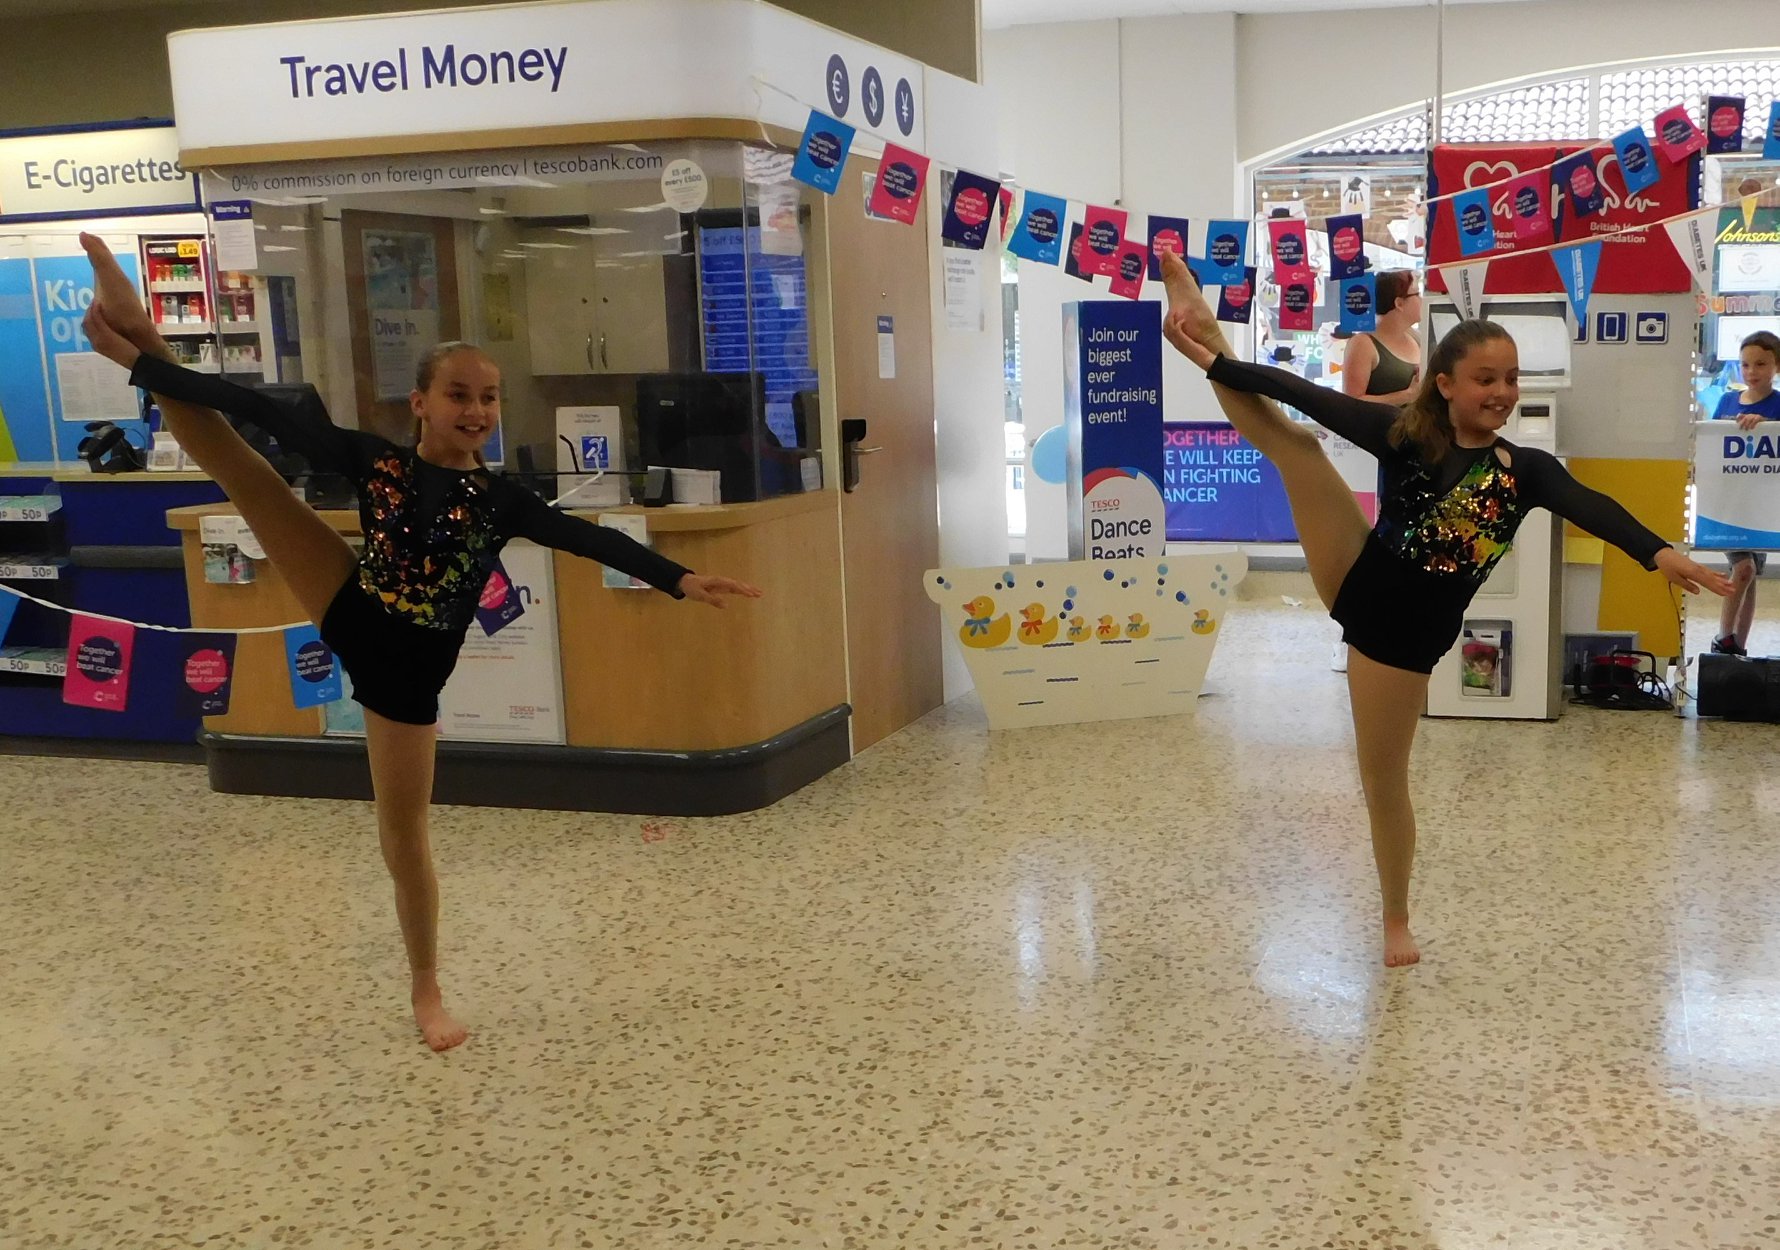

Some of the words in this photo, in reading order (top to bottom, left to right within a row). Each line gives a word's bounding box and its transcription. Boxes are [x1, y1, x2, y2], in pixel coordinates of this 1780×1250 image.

[280, 48, 409, 98] Travel
[421, 44, 568, 92] Money
[24, 158, 187, 193] E-Cigarettes
[232, 175, 258, 192] 0%
[263, 173, 356, 190] commission
[362, 171, 381, 184] on
[387, 166, 443, 184] foreign
[449, 162, 518, 180] currency
[533, 153, 663, 174] tescobank.com
[1590, 222, 1620, 232] British
[44, 280, 95, 312] Kio
[375, 318, 400, 335] Dive
[1088, 327, 1114, 342] Join
[1118, 330, 1139, 341] our
[1088, 348, 1132, 366] biggest
[1088, 371, 1115, 383] ever
[1088, 387, 1157, 404] fundraising
[1088, 408, 1127, 424] event!
[1163, 430, 1239, 446] OGETHER
[1723, 435, 1780, 459] DiA
[1163, 450, 1175, 465] E
[1179, 450, 1218, 465] WILL
[1223, 449, 1262, 465] KEEP
[1163, 469, 1175, 483] N
[1181, 468, 1260, 483] FIGHTING
[1723, 465, 1760, 474] KNOW
[1164, 487, 1218, 502] ANCER
[1091, 499, 1120, 509] TESCO
[1091, 519, 1151, 541] Dance
[1092, 544, 1145, 560] Beats
